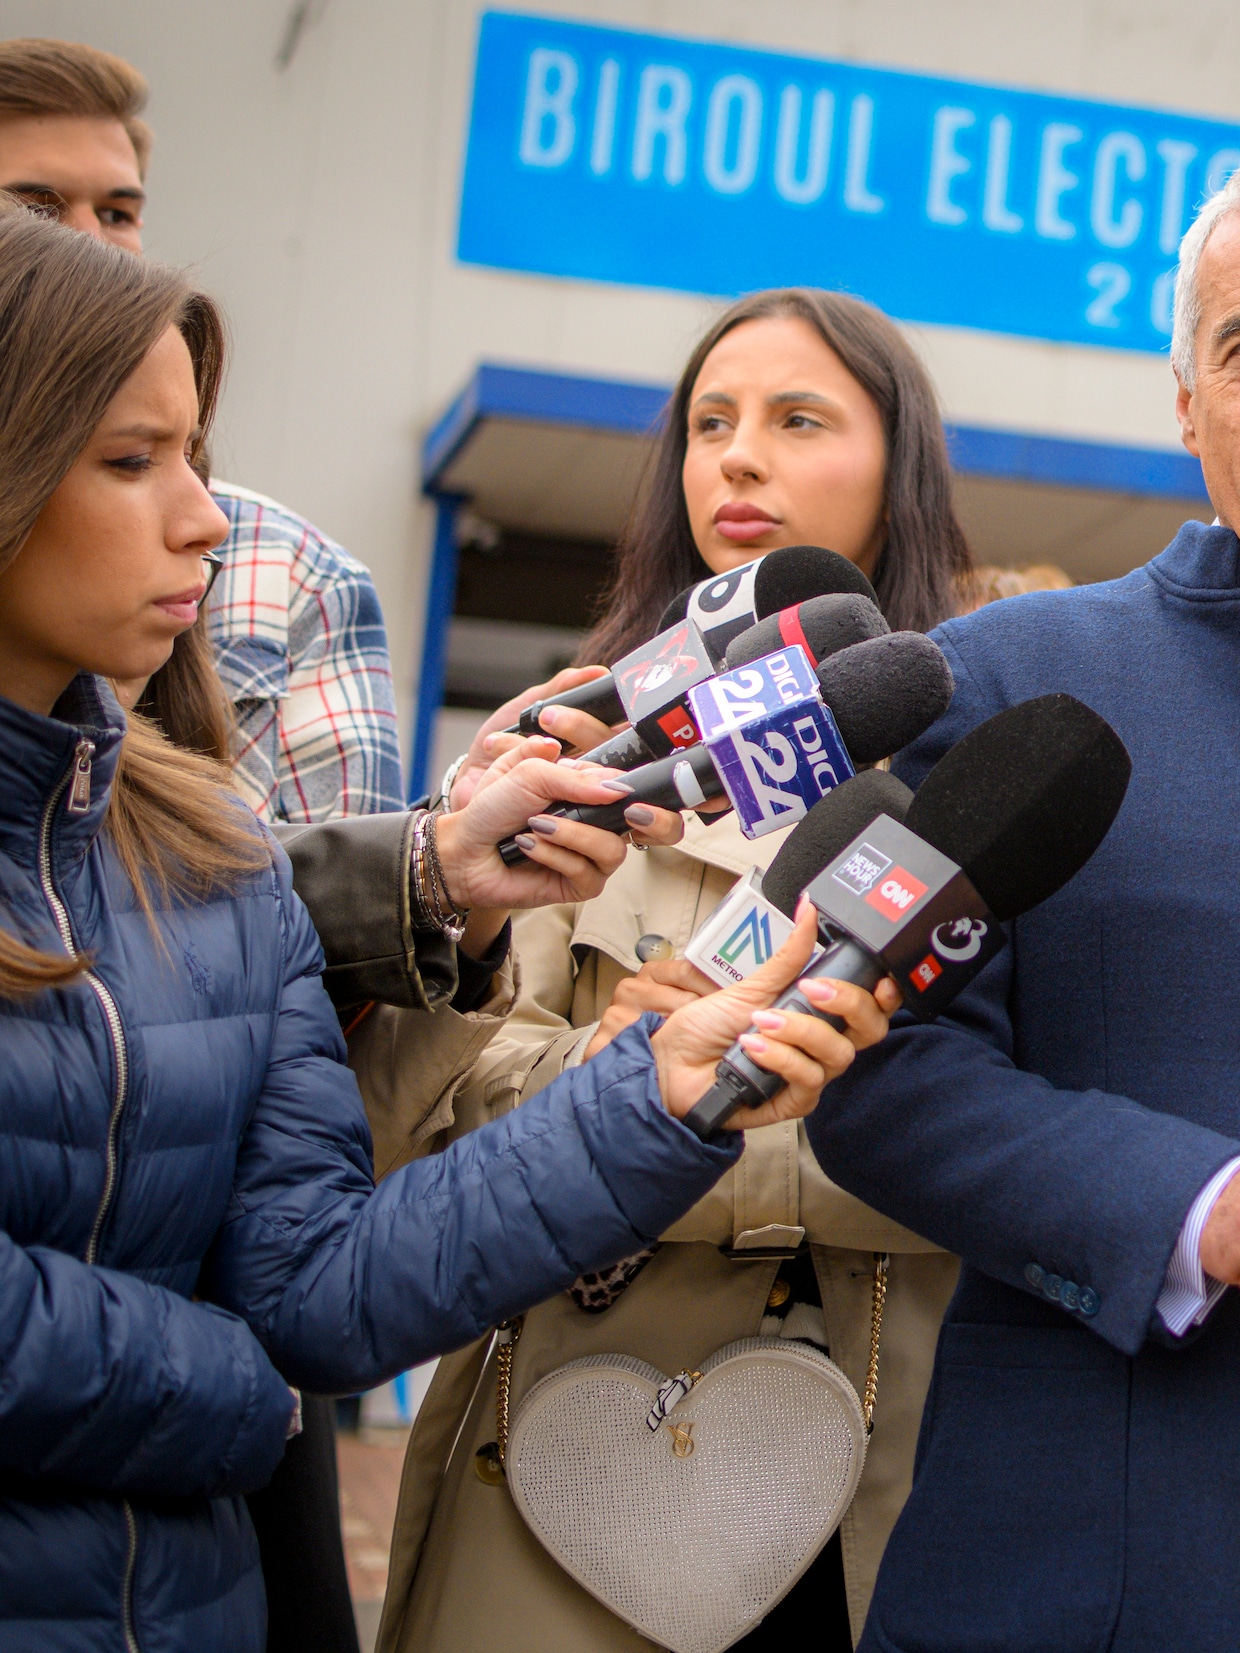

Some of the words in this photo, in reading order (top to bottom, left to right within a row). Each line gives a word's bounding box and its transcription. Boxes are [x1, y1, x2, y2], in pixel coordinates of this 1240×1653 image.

[519, 47, 884, 214] BIROUL
[707, 669, 768, 736] 24
[793, 715, 841, 797] DIG
[730, 729, 808, 838] 24
[843, 861, 873, 885] HOUR
[851, 852, 880, 876] NEWS
[880, 880, 915, 909] CNN
[711, 954, 746, 982] METRO
